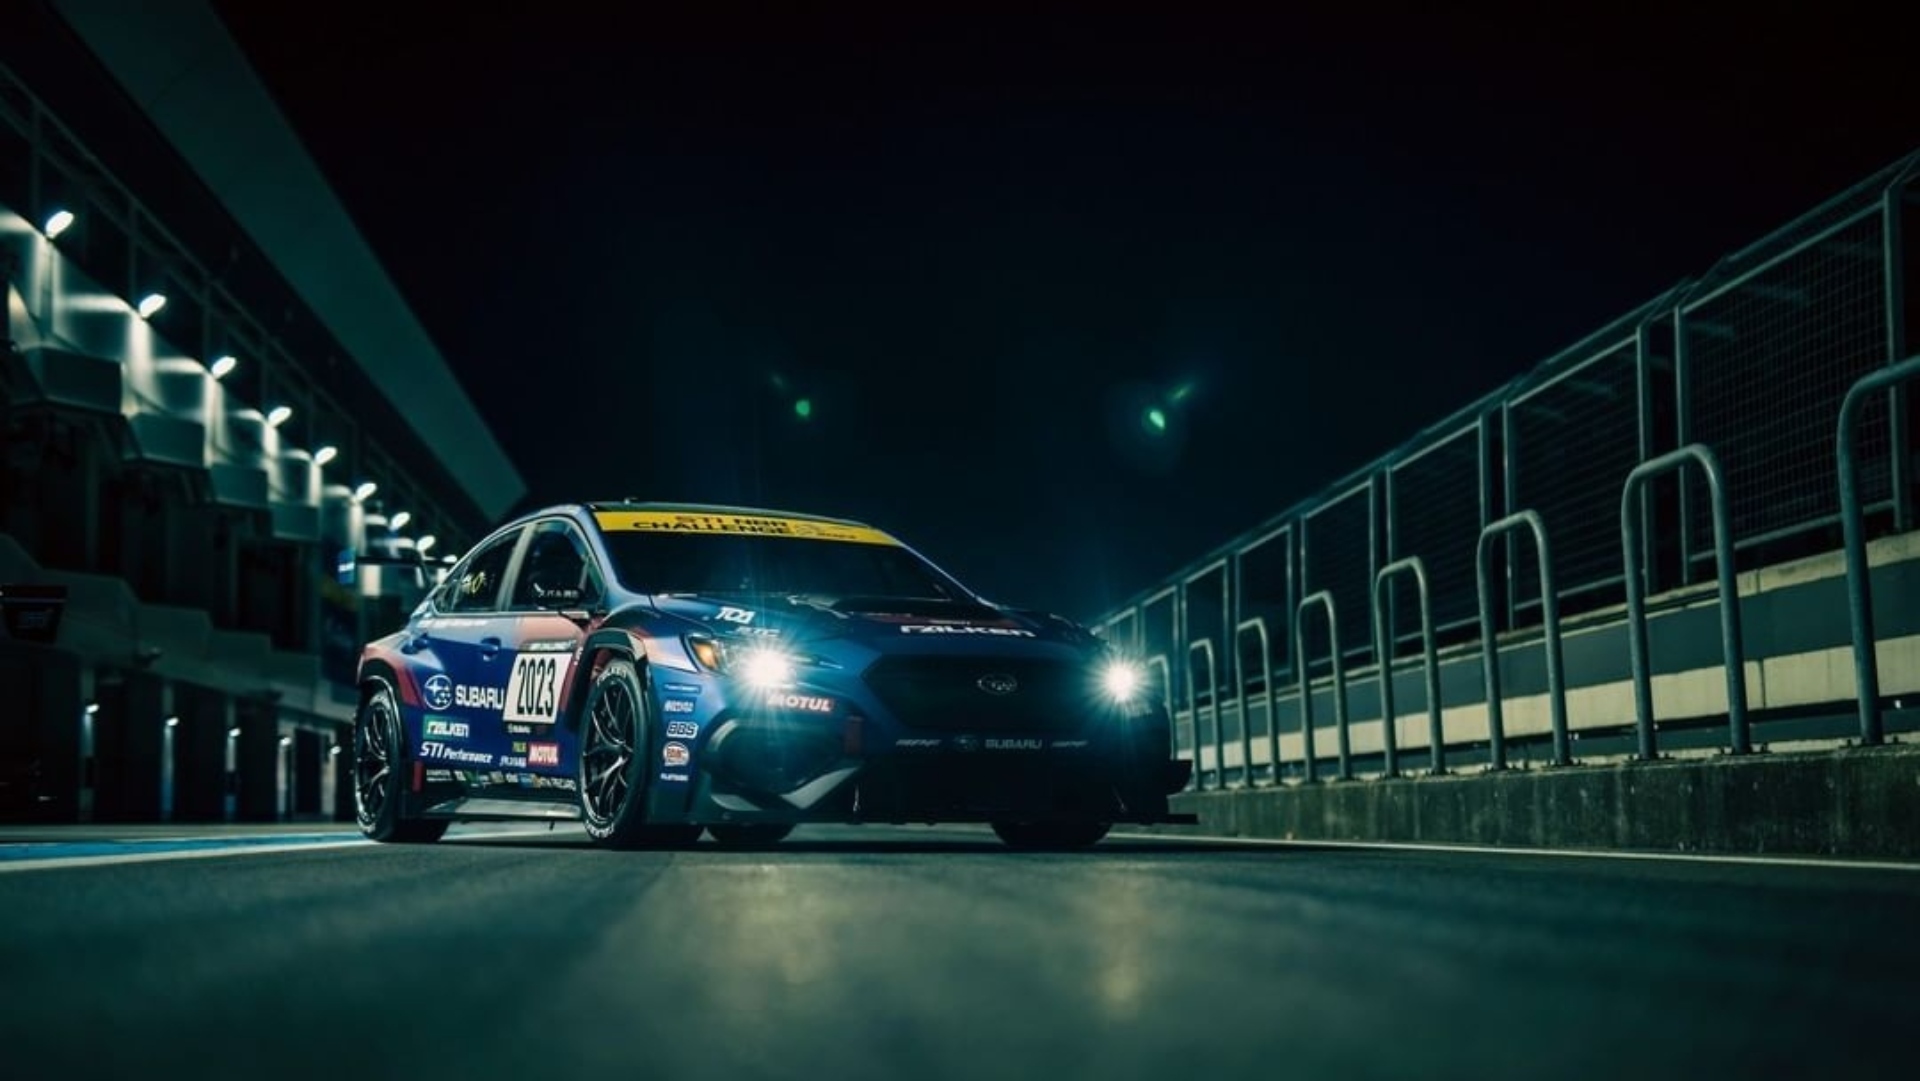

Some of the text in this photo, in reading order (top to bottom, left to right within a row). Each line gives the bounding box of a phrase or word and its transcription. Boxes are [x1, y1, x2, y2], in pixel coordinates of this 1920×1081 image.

[632, 521, 792, 535] CHALLENGE
[900, 625, 1037, 638] FALKEN
[517, 658, 556, 717] 2023
[454, 684, 504, 710] SUBARU
[767, 696, 831, 711] MOTUL
[426, 721, 469, 738] FALKEN
[419, 741, 446, 759] STI
[443, 747, 493, 764] Performance
[984, 738, 1043, 750] SUBARU
[529, 744, 558, 765] MOTUL
